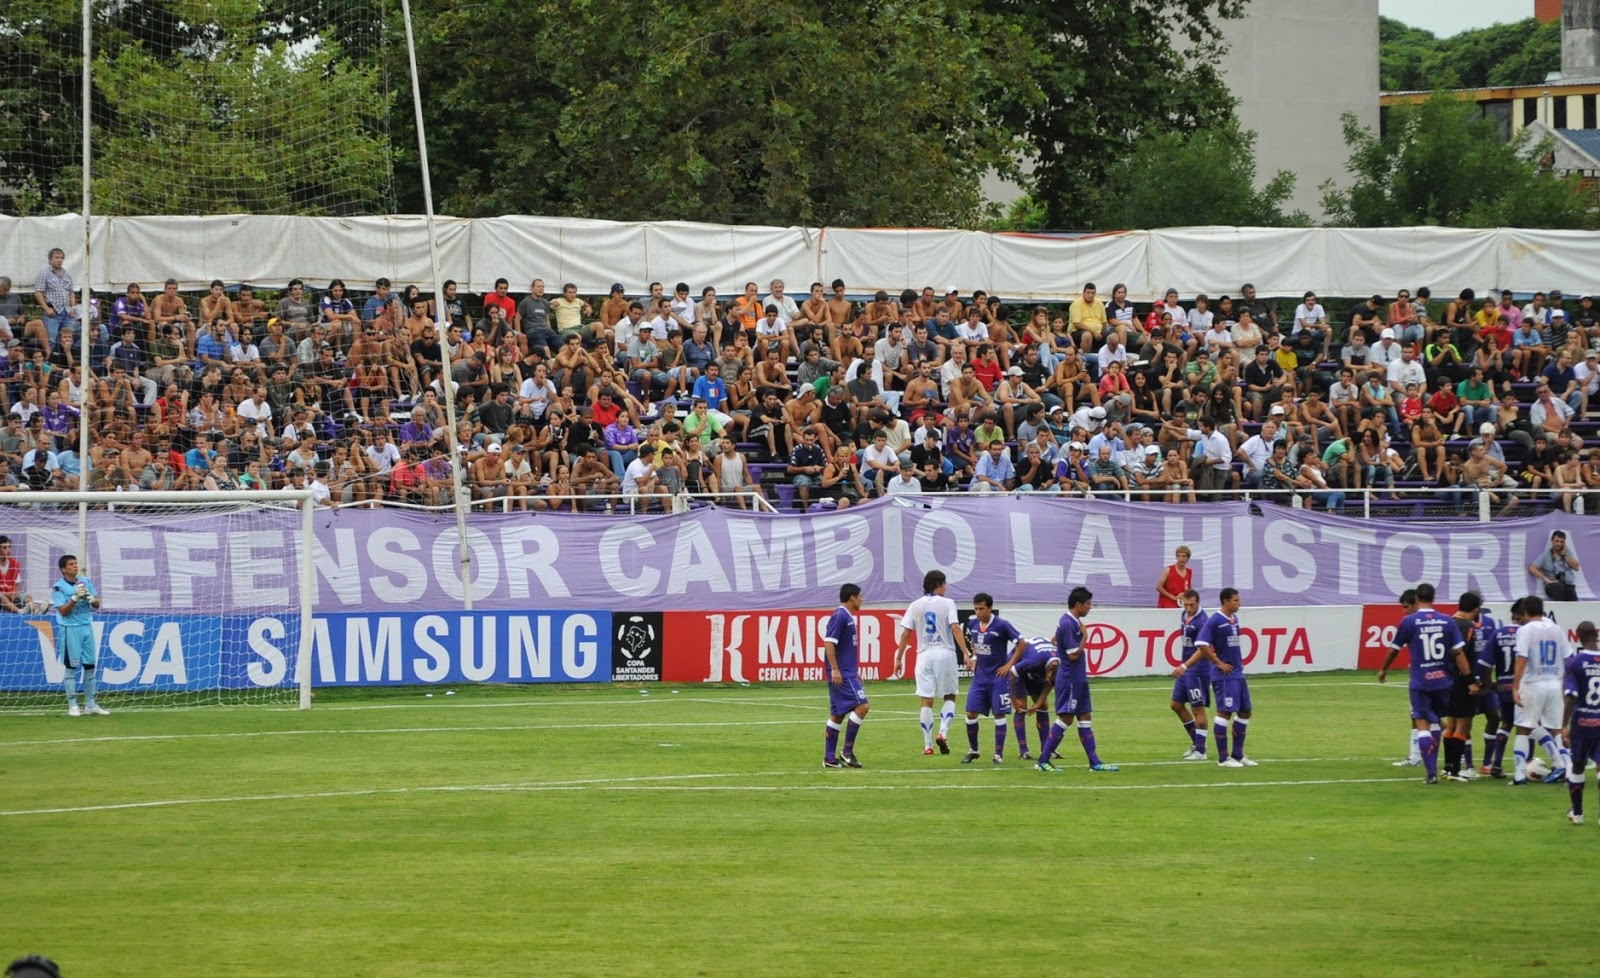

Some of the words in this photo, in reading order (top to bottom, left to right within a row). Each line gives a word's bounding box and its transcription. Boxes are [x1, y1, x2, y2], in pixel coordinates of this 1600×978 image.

[26, 524, 571, 608] DEFENSOR
[599, 497, 976, 597] CAMBIÓ
[1009, 511, 1131, 586] LA
[924, 611, 937, 634] 9
[247, 613, 597, 687] SAMSUNG
[758, 615, 880, 664] KAIR
[1138, 626, 1313, 668] TTA
[1419, 632, 1445, 661] 16
[1539, 640, 1557, 666] 10
[758, 667, 799, 681] CERVEJA
[804, 667, 823, 681] BEM
[999, 693, 1011, 706] 15
[1189, 688, 1201, 700] 10
